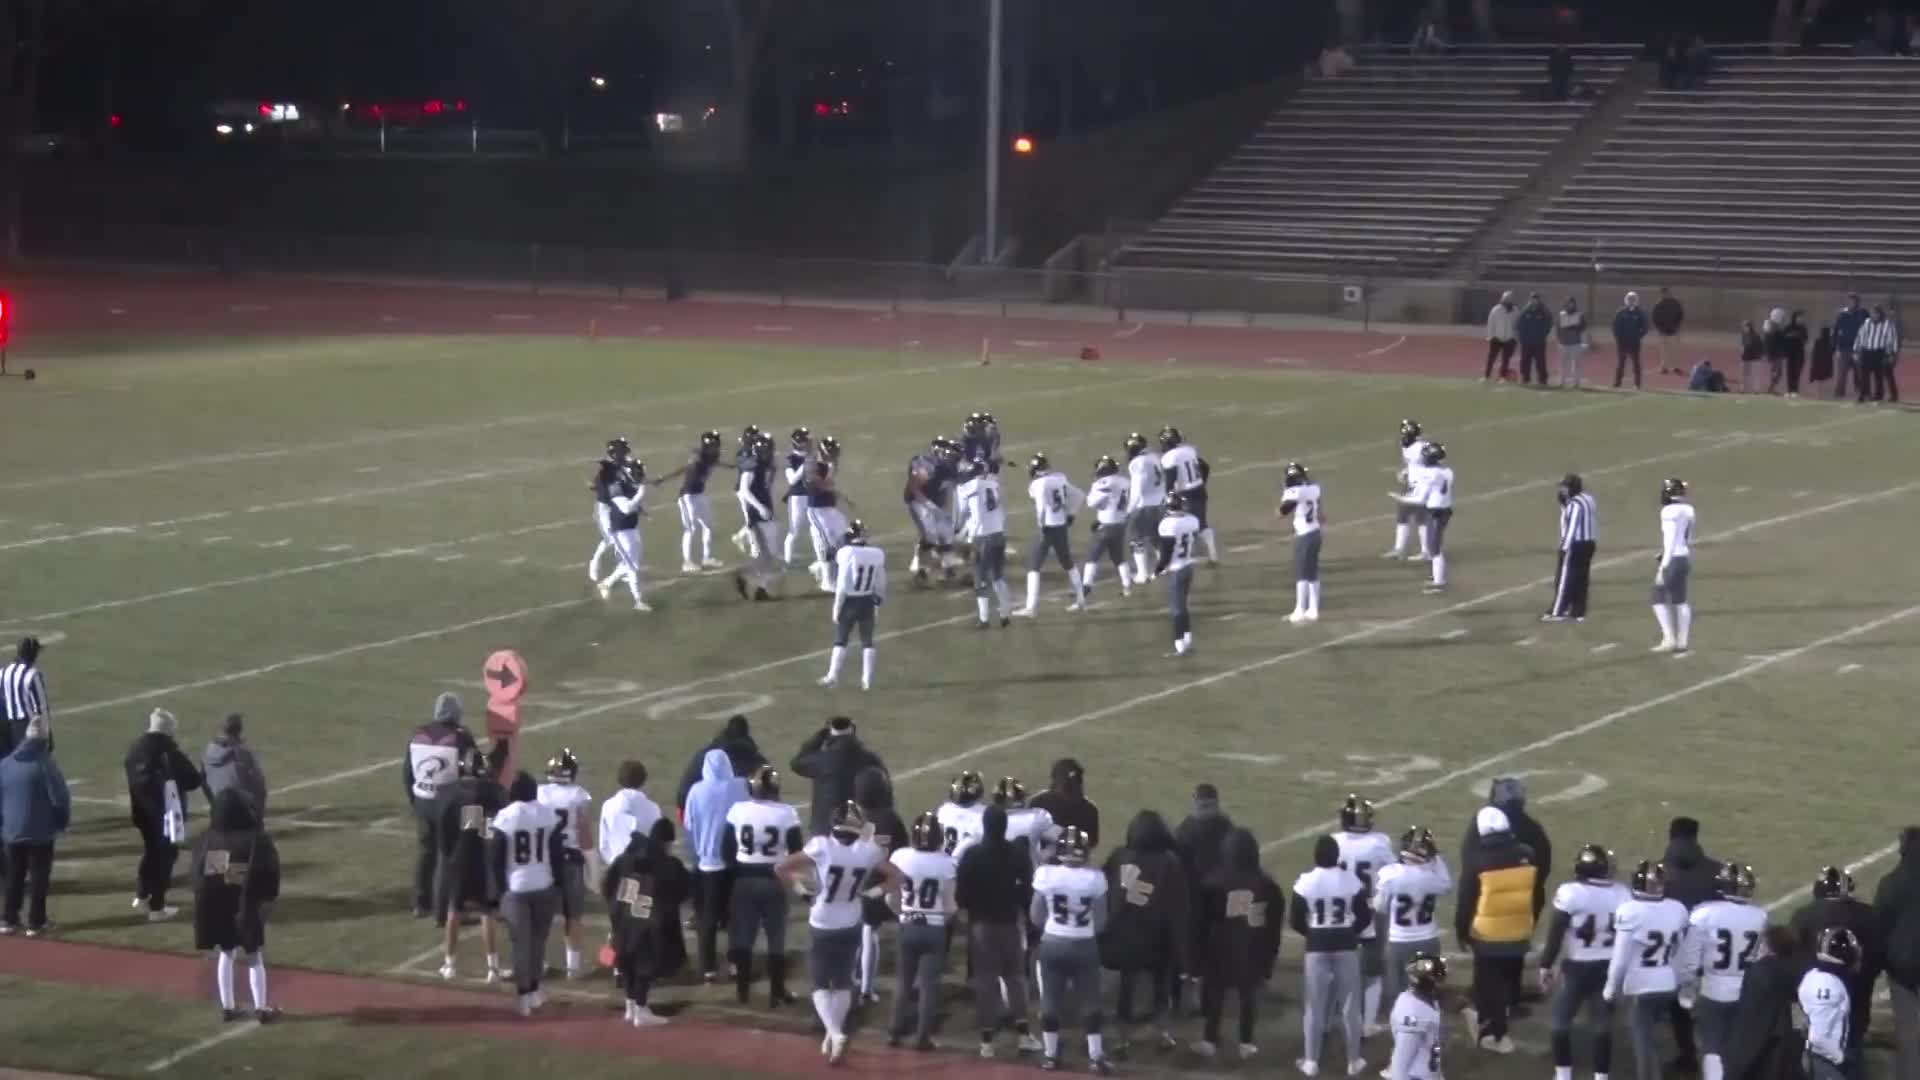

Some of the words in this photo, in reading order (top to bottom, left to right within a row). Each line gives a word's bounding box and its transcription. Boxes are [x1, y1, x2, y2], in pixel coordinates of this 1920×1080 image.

[514, 827, 546, 866] 81
[740, 823, 780, 857] 92
[824, 866, 867, 904] 77
[1053, 893, 1093, 929] 52
[1315, 897, 1346, 926] 13
[1713, 927, 1760, 972] 32
